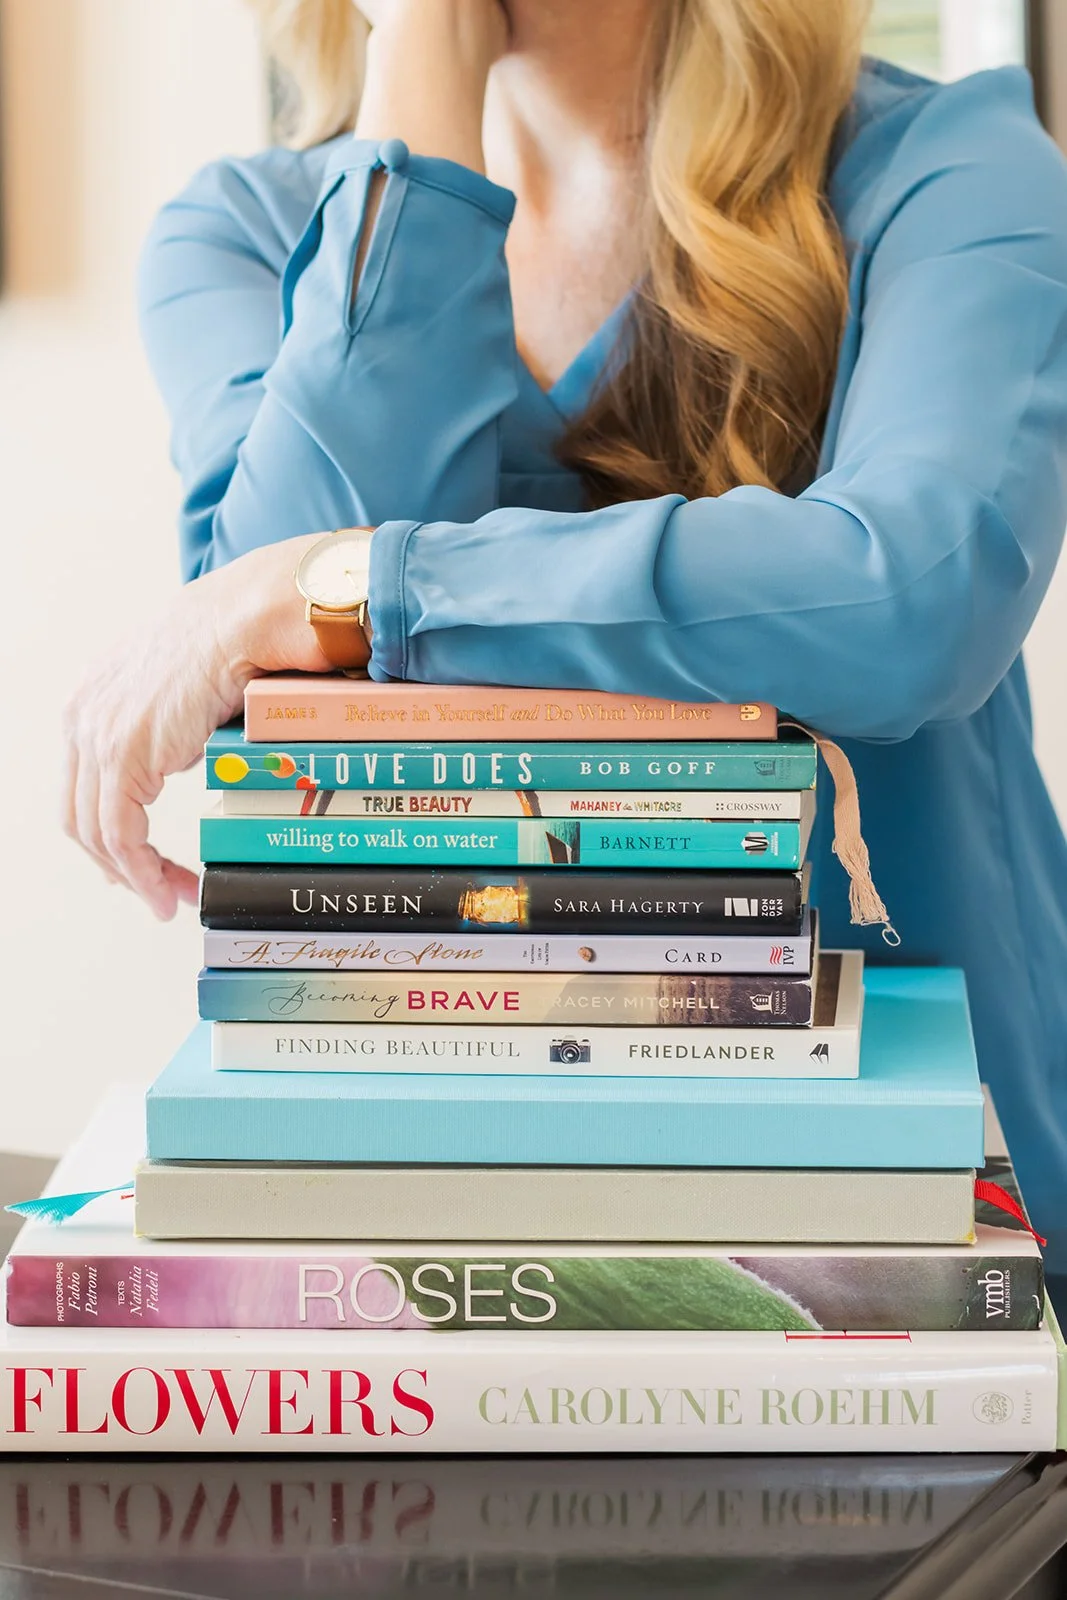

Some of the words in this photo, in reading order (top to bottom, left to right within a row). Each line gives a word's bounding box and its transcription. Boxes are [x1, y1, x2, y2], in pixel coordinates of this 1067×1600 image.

[265, 706, 318, 720] JAMES
[344, 703, 407, 722] Believe
[412, 704, 431, 722] in
[434, 703, 506, 722] Yourself
[510, 704, 540, 721] and
[544, 703, 573, 722] Do
[577, 703, 627, 722] What
[631, 703, 665, 722] You
[669, 703, 712, 722] Love
[309, 752, 406, 785] LOVE
[433, 751, 533, 785] DOES
[579, 761, 632, 775] BOB
[647, 762, 717, 776] GOFF
[362, 796, 404, 813] TRUE
[408, 796, 473, 814] BEAUTY
[570, 800, 622, 812] MAHANEY
[634, 801, 682, 812] WHITACRE
[726, 802, 783, 812] CROSSWAY
[266, 828, 334, 852] willing
[338, 831, 360, 848] to
[364, 828, 408, 849] walk
[412, 834, 438, 849] on
[443, 831, 499, 849] water
[599, 836, 691, 850] BARNETT
[290, 888, 422, 915] UNSEEN
[553, 898, 602, 913] SARA
[610, 899, 704, 914] HAGERTY
[228, 940, 273, 965] A
[271, 939, 381, 968] Fragile
[383, 941, 484, 966] Stone
[664, 949, 722, 964] CARD
[783, 945, 795, 965] IVP
[261, 981, 400, 1019] Becoming
[407, 990, 520, 1011] BRAVE
[538, 996, 616, 1009] RACEY
[624, 996, 720, 1010] MITCHELL
[275, 1038, 376, 1055] FINDING
[386, 1040, 521, 1058] BEAUTIFUL
[628, 1044, 776, 1061] FRIEDLANDER
[56, 1261, 64, 1322] PHOTOGRAPHS
[67, 1271, 81, 1312] Fabio
[84, 1264, 98, 1316] Petroni
[117, 1280, 126, 1306] TEXTS
[129, 1264, 143, 1317] Natalia
[146, 1268, 159, 1312] Fedeli
[298, 1263, 557, 1323] ROSES
[977, 1269, 1005, 1319] vmb
[1004, 1269, 1012, 1319] PUBLISHERS
[5, 1366, 436, 1437] FLOWERS
[478, 1386, 743, 1426] CAROLYNE
[757, 1387, 939, 1427] ROEHM
[1021, 1389, 1033, 1425] Potter
